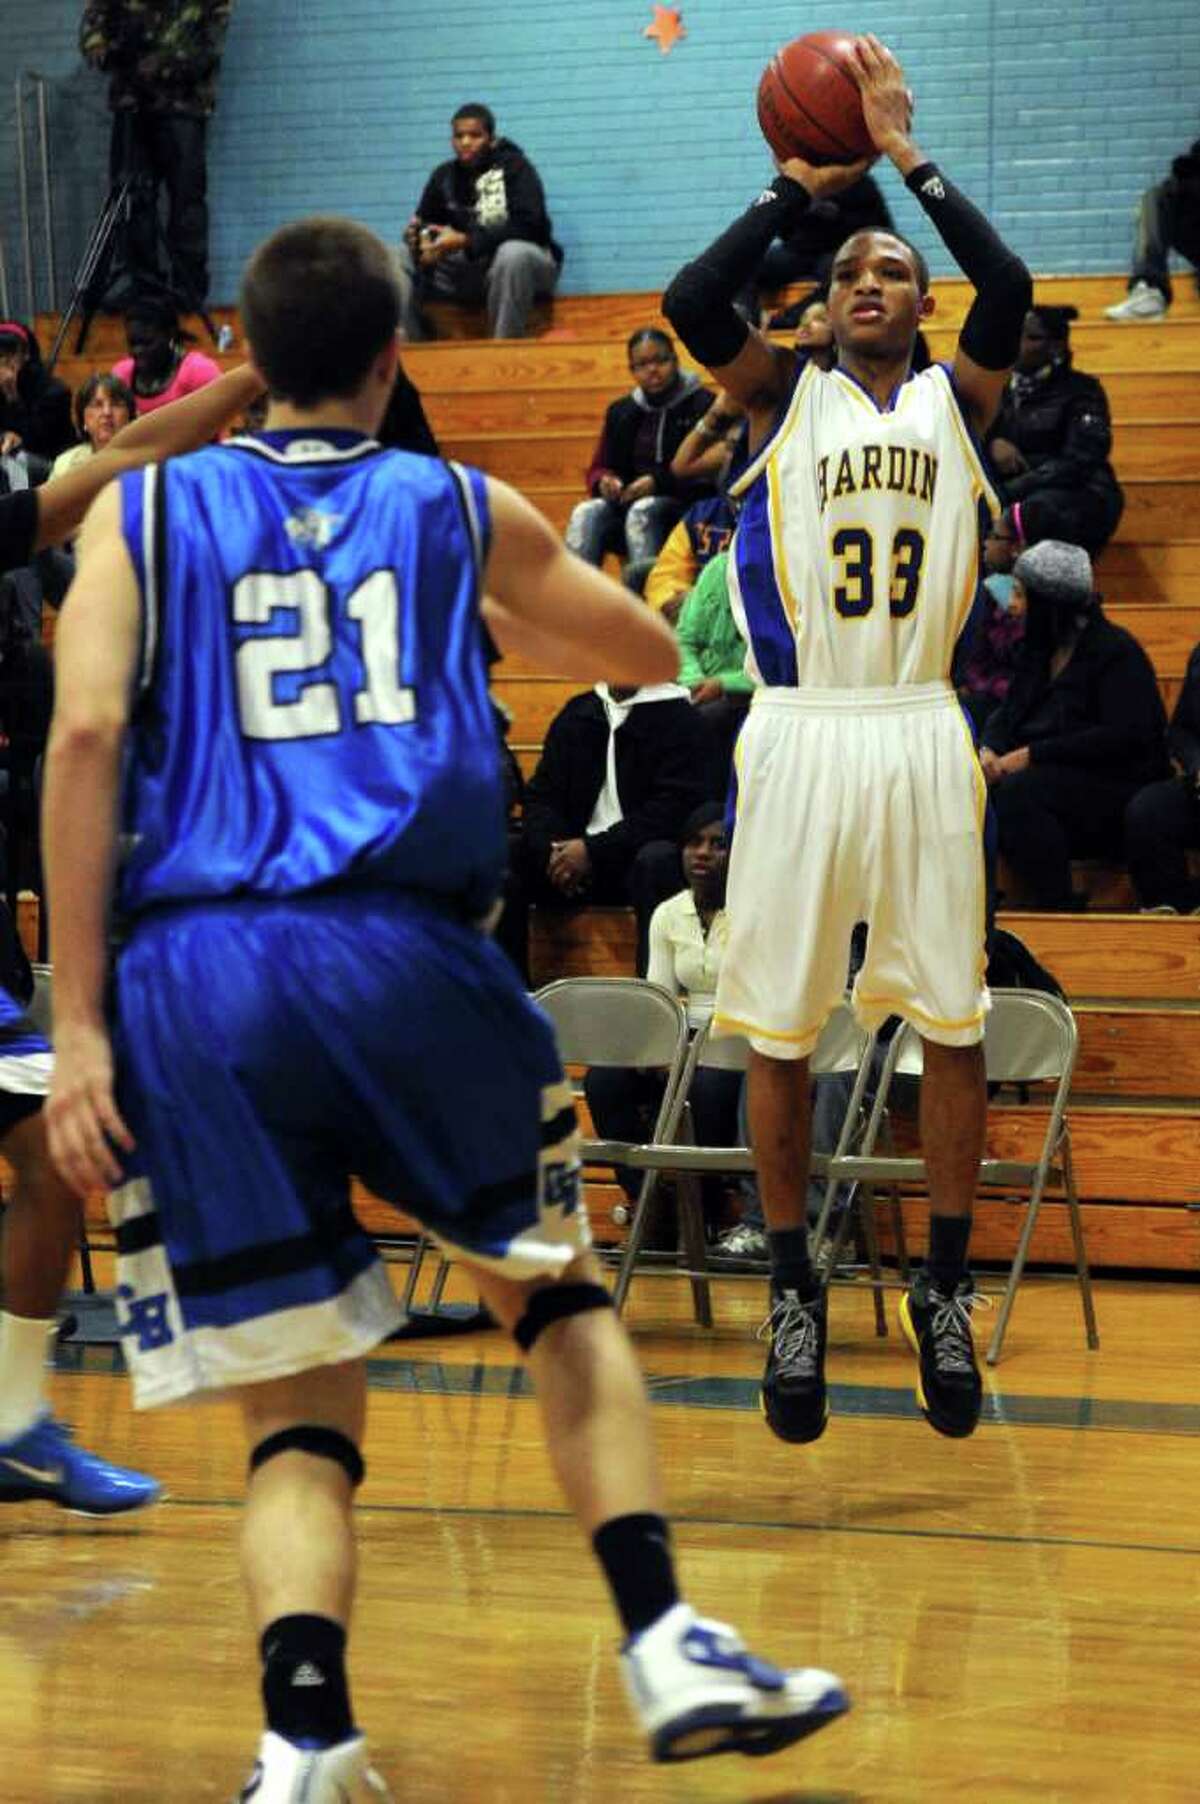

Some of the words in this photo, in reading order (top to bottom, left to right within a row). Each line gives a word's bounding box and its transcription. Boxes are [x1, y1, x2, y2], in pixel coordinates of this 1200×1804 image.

[817, 445, 938, 513] HARDIN
[832, 527, 925, 618] 33
[232, 568, 417, 740] 21
